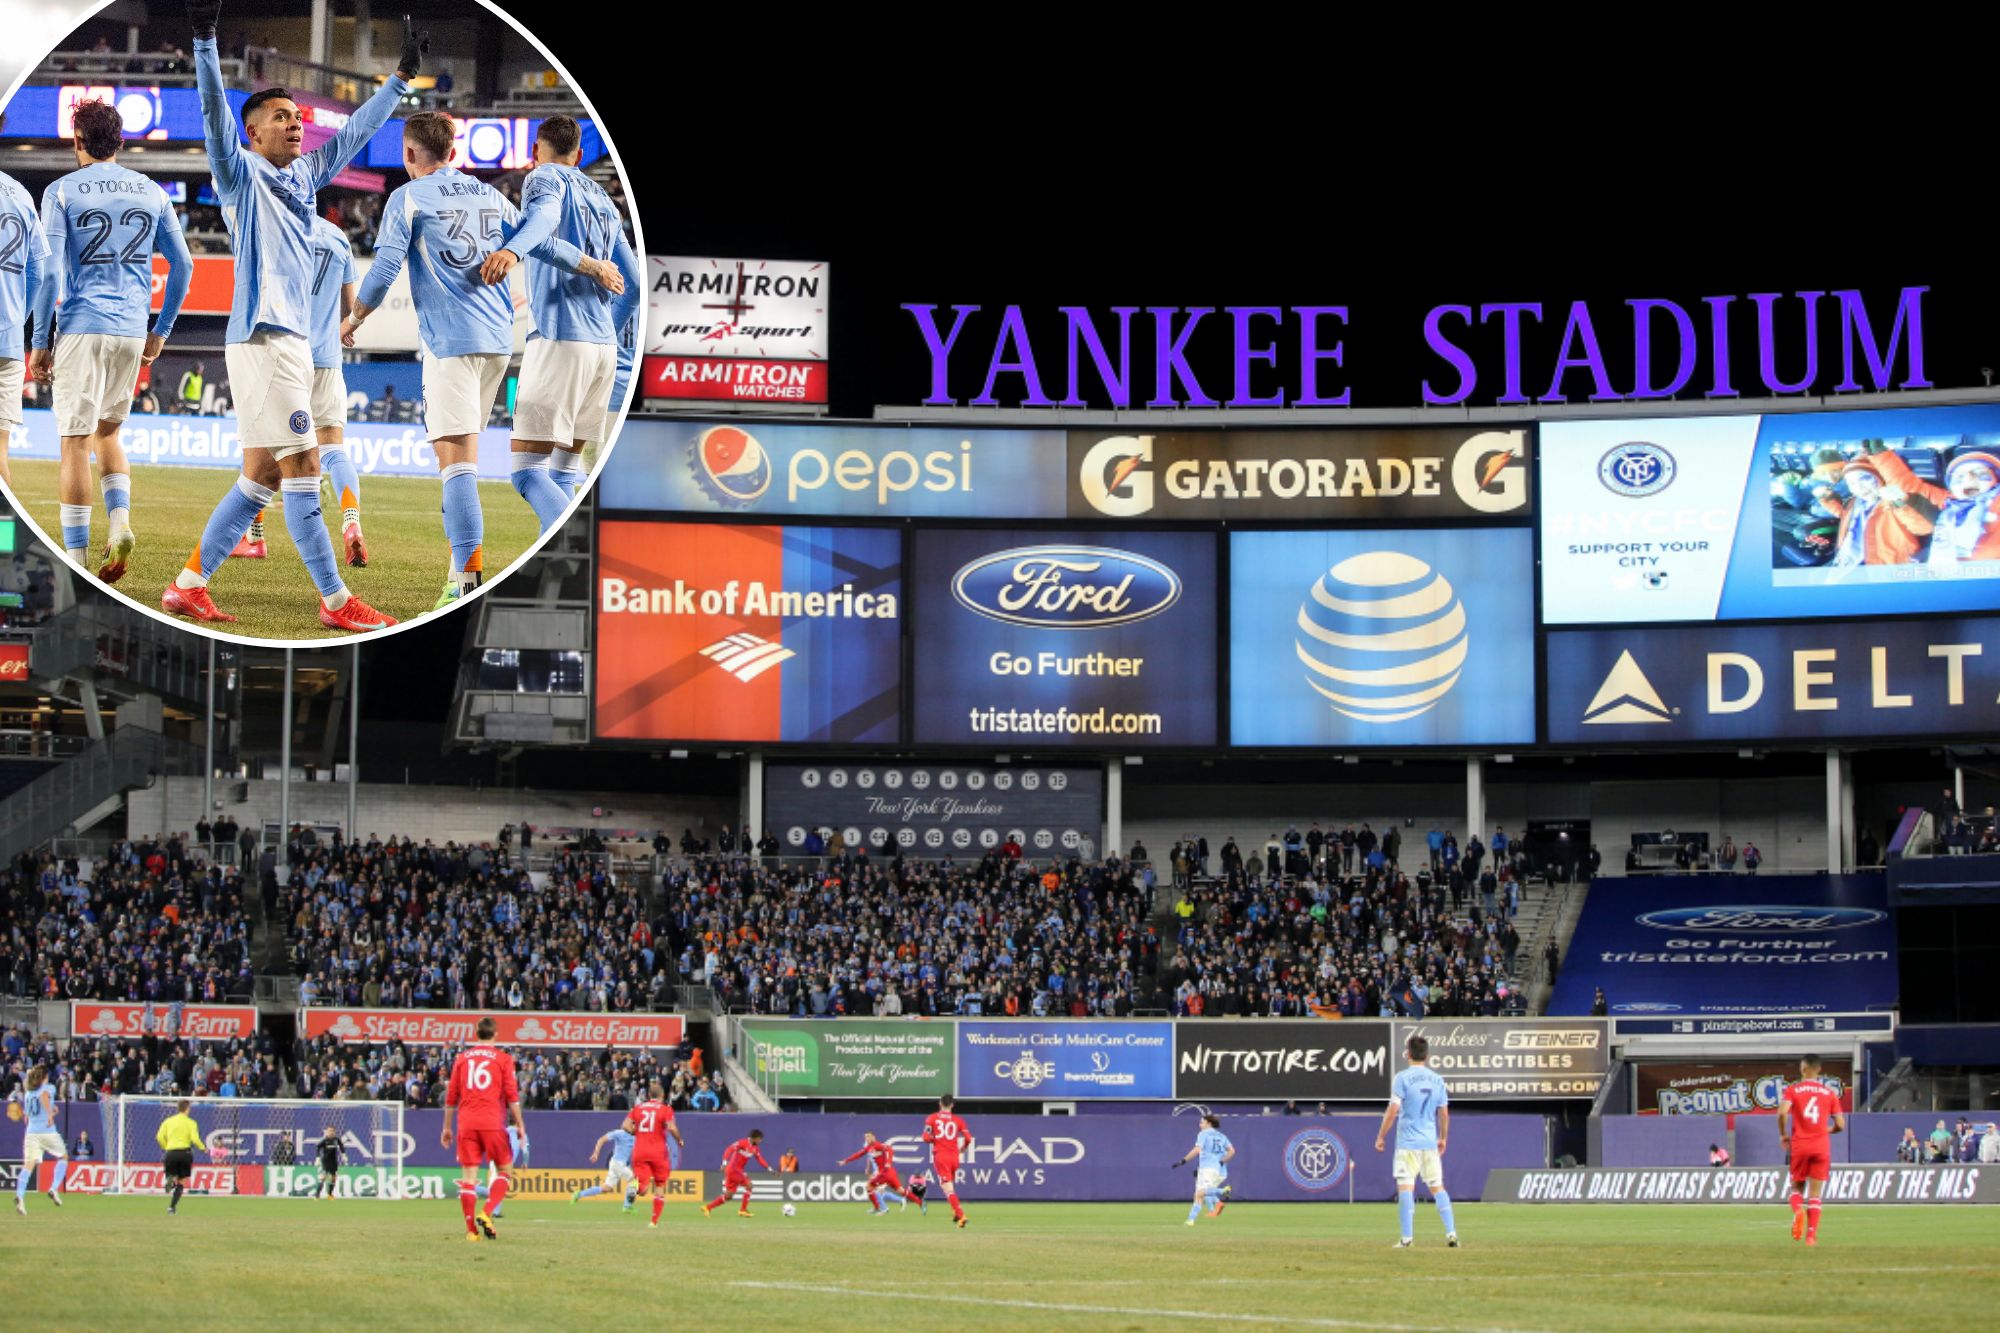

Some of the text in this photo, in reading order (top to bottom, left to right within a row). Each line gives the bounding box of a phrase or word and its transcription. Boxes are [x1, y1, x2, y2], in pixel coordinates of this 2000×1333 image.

[77, 207, 152, 266] 22
[652, 271, 819, 298] ARMITRON
[738, 325, 812, 339] sport
[901, 285, 1934, 407] YANKEE STADIUM
[659, 361, 809, 386] ARMITRON
[733, 385, 805, 398] WATCHES
[788, 440, 972, 505] pepsi
[1164, 458, 1443, 499] GATORADE
[1568, 541, 1710, 554] SUPPORT YOUR
[1618, 556, 1659, 567] CITY
[997, 557, 1136, 613] Ford
[602, 578, 898, 619] Bank of America
[990, 651, 1144, 676] Go Further
[1707, 643, 2000, 714] DELT
[970, 708, 1162, 735] tristateford.com
[865, 796, 900, 813] New
[902, 796, 940, 822] York
[1686, 908, 1838, 928] Ford
[1666, 939, 1837, 949] Go Further
[1601, 951, 1888, 963] tristateford.com
[185, 1012, 241, 1034] Farm
[364, 1015, 475, 1038] State Farm
[550, 1019, 660, 1042] State Farm
[1702, 1020, 1804, 1033] pinstripebowl.com
[824, 1033, 840, 1042] The
[1030, 1033, 1063, 1046] Circle
[1066, 1033, 1123, 1046] MultiCare
[1125, 1033, 1165, 1046] Center
[1505, 1032, 1598, 1047] STEINER
[754, 1043, 806, 1058] Clean
[835, 1045, 933, 1054] Products Partner of the
[1181, 1043, 1386, 1075] NITTOTIRE.COM
[1429, 1054, 1574, 1068] COLLECTIBLES
[467, 1059, 492, 1090] 16
[829, 1062, 855, 1077] New
[857, 1063, 885, 1083] York
[1443, 1081, 1600, 1093] NERSPORTS.COM
[1657, 1076, 1842, 1116] Peanut Chs
[1419, 1088, 1432, 1118] 7
[1803, 1096, 1819, 1124] 4
[638, 1110, 656, 1132] 21
[935, 1120, 958, 1140] 30
[267, 1166, 446, 1199] Heneken
[787, 1175, 870, 1200] adida
[924, 1168, 1046, 1185] ARWAYS
[1518, 1172, 1585, 1200] OFFICIAL
[1587, 1172, 1636, 1200] DAILY
[1635, 1172, 1710, 1200] FANTASY
[1710, 1171, 1780, 1199] SPORTS
[1867, 1170, 1895, 1199] OF
[1897, 1169, 1935, 1199] THE
[1935, 1168, 1980, 1199] MLS
